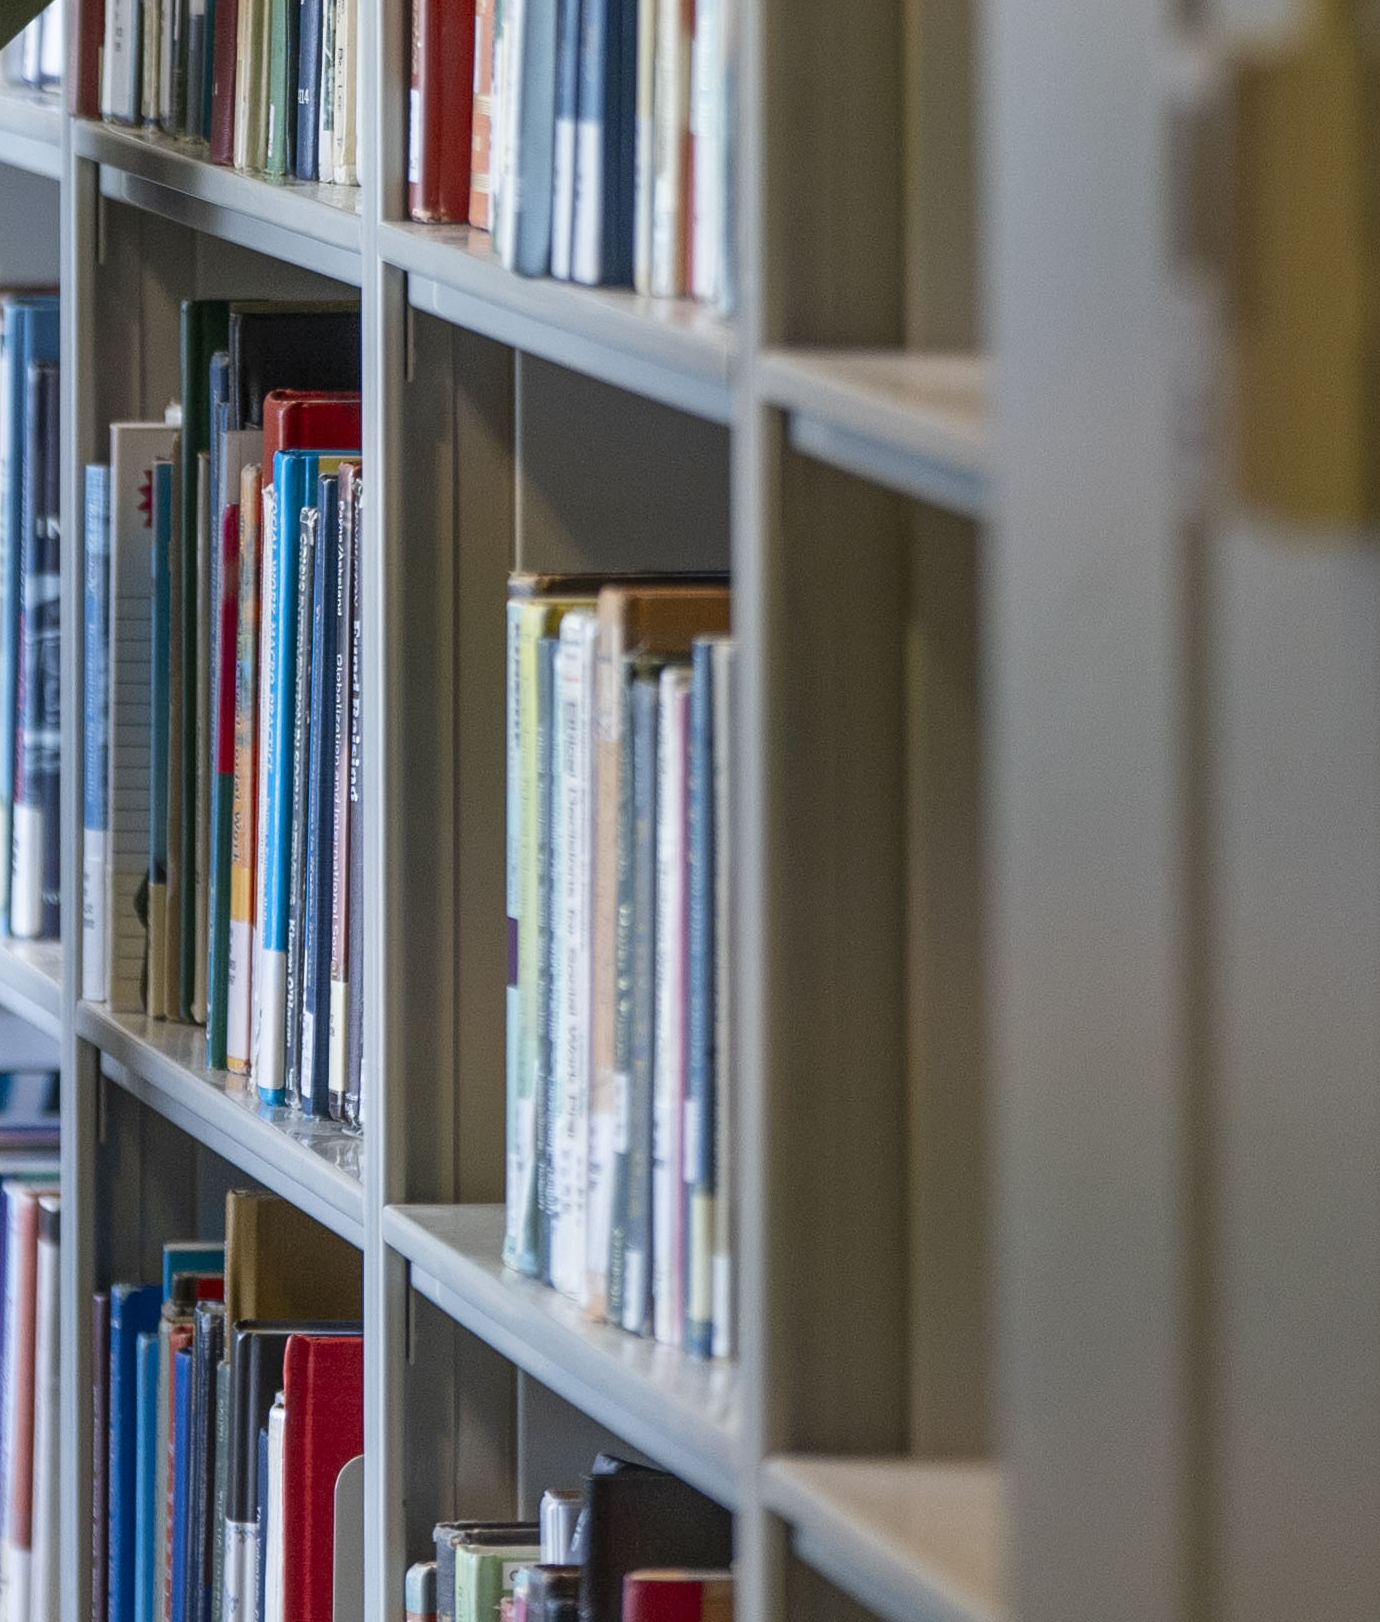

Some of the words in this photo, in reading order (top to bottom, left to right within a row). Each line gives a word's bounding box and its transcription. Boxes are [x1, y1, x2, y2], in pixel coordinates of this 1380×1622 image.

[335, 654, 343, 766] Globalization
[333, 809, 341, 918] International
[331, 926, 339, 977] Social
